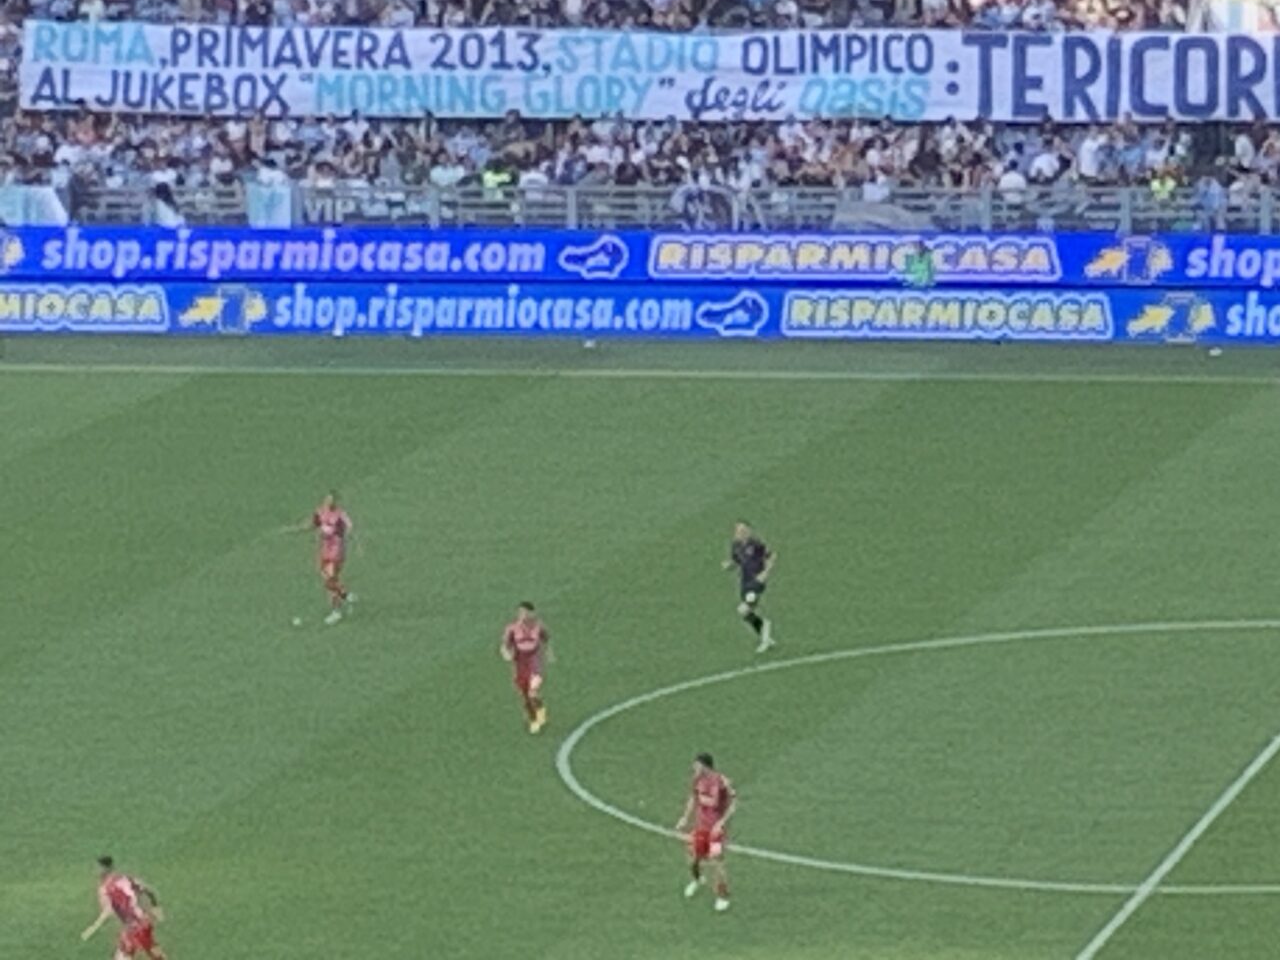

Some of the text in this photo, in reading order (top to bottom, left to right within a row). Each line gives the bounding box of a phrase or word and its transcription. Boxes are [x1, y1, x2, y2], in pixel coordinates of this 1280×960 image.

[555, 31, 720, 72] STADIO
[31, 68, 85, 105] AL
[96, 71, 290, 117] JUKEBOX
[685, 76, 785, 116] degli
[42, 228, 545, 278] shop.risparmiocasa.com
[276, 284, 693, 337] shop.risparmiocasa.com
[789, 298, 1103, 329] RISPARMIOCASA
